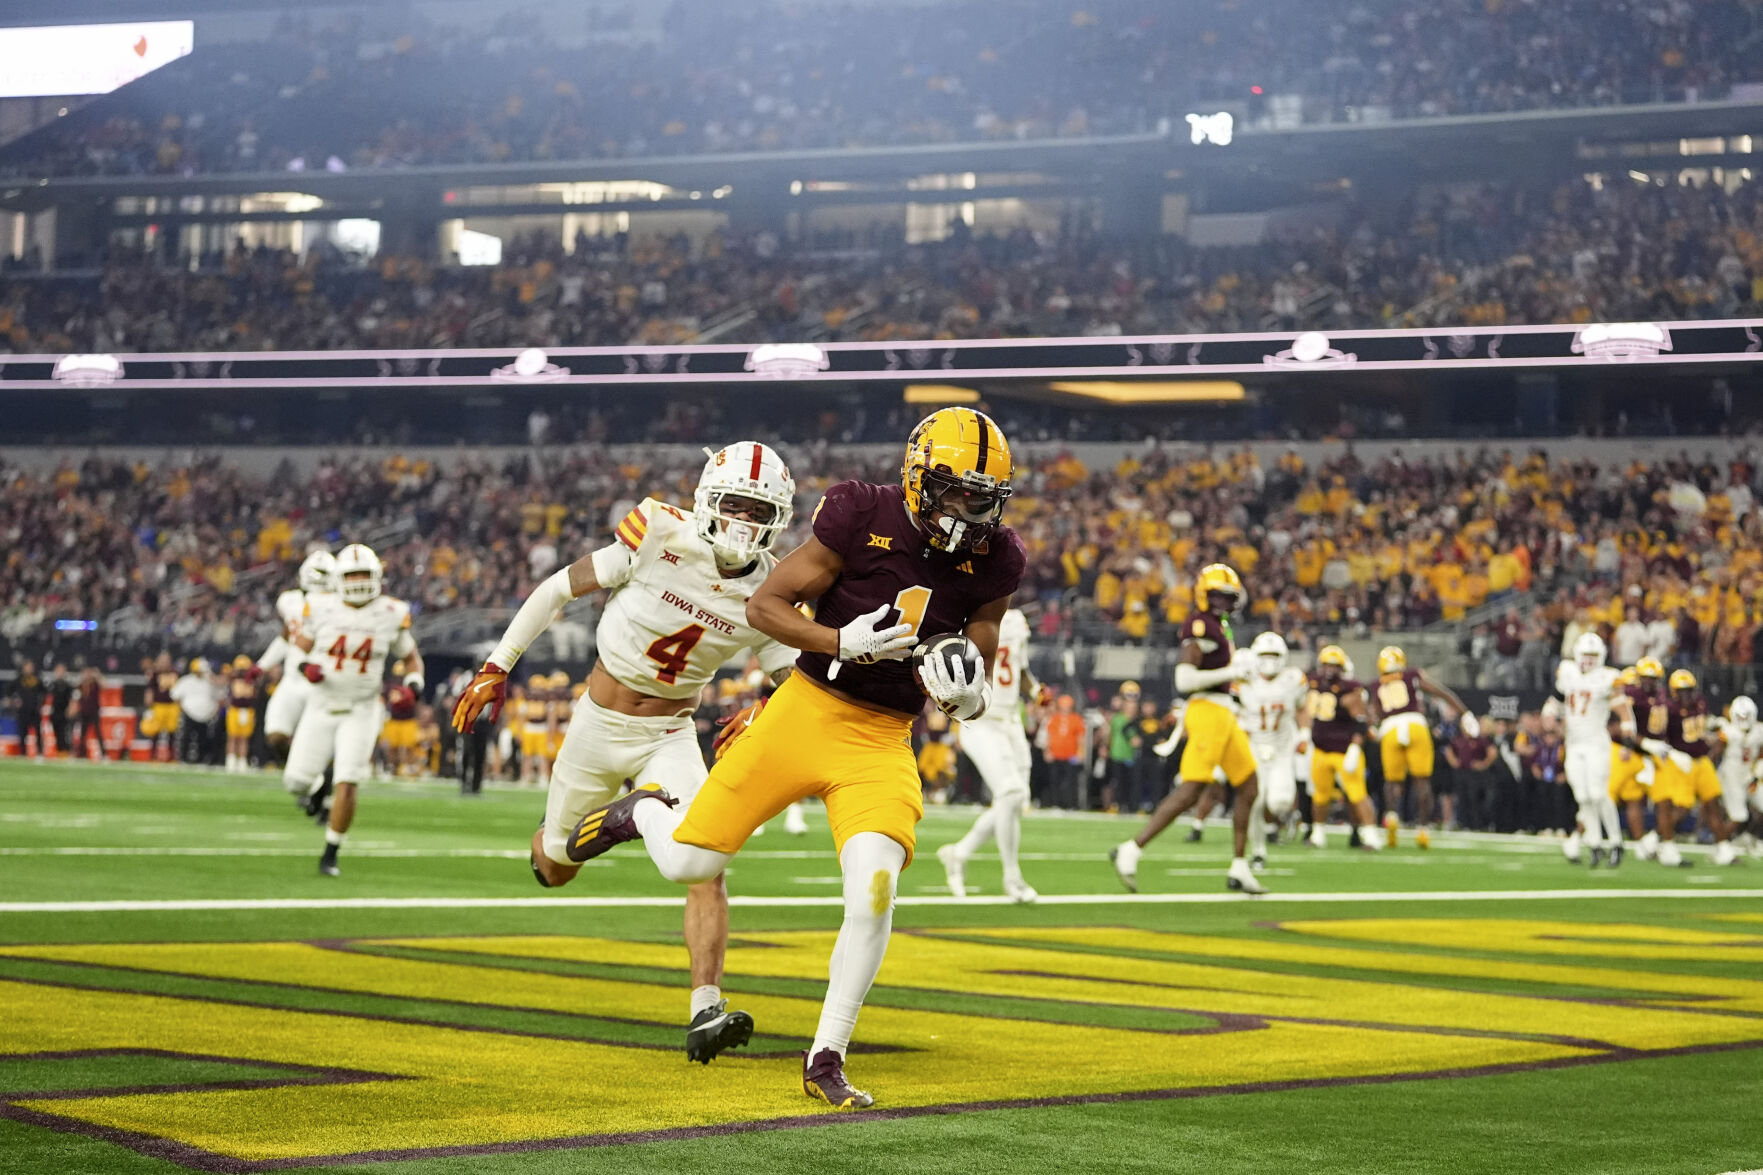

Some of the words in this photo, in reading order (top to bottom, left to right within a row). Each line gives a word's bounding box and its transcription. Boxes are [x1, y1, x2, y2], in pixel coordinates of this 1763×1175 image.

[659, 548, 681, 567] XII
[867, 533, 893, 551] XII
[661, 590, 693, 615] IOWA
[695, 609, 736, 636] STATE
[891, 585, 932, 661] 1
[327, 634, 374, 674] 44
[645, 622, 707, 687] 4
[1259, 703, 1285, 732] 17
